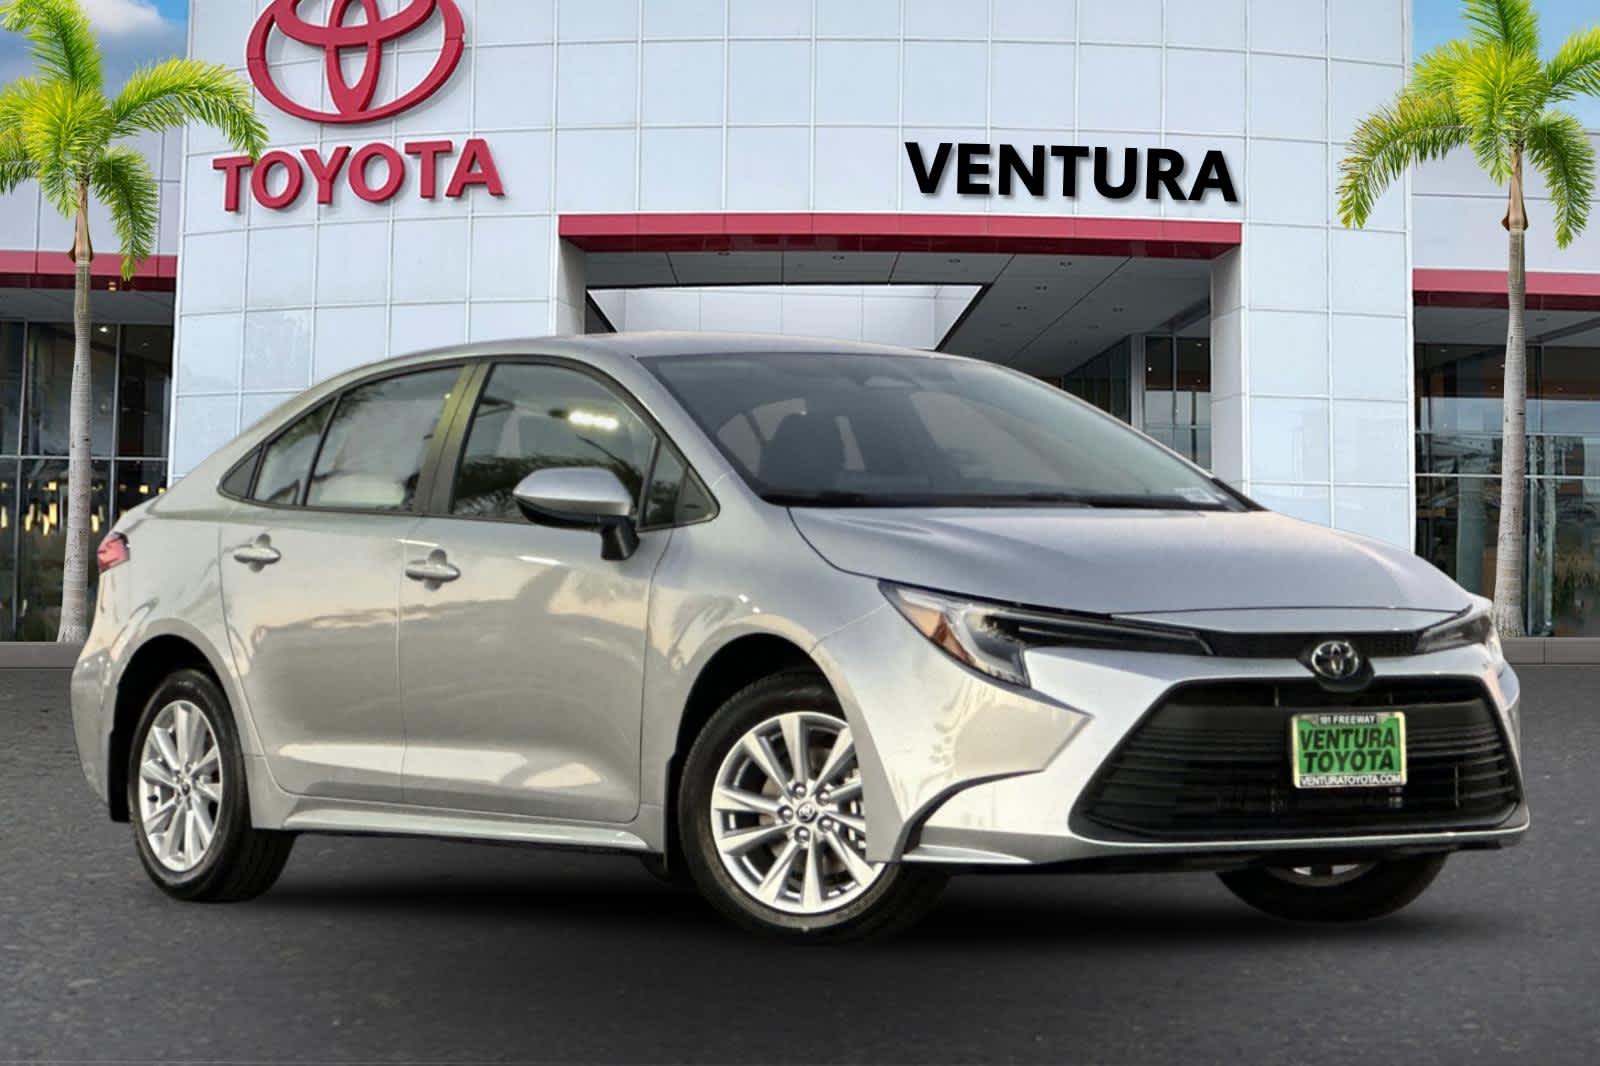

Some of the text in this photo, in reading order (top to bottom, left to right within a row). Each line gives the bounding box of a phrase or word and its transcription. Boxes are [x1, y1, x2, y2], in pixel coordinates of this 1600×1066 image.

[213, 138, 505, 212] TOYOTA
[904, 141, 1239, 203] VENTURA
[1333, 715, 1376, 724] FREEWAY
[1300, 727, 1395, 750] VENTURA
[1304, 749, 1394, 773] TOYOTA
[1300, 775, 1401, 786] VENTURATOYOTA.COM
